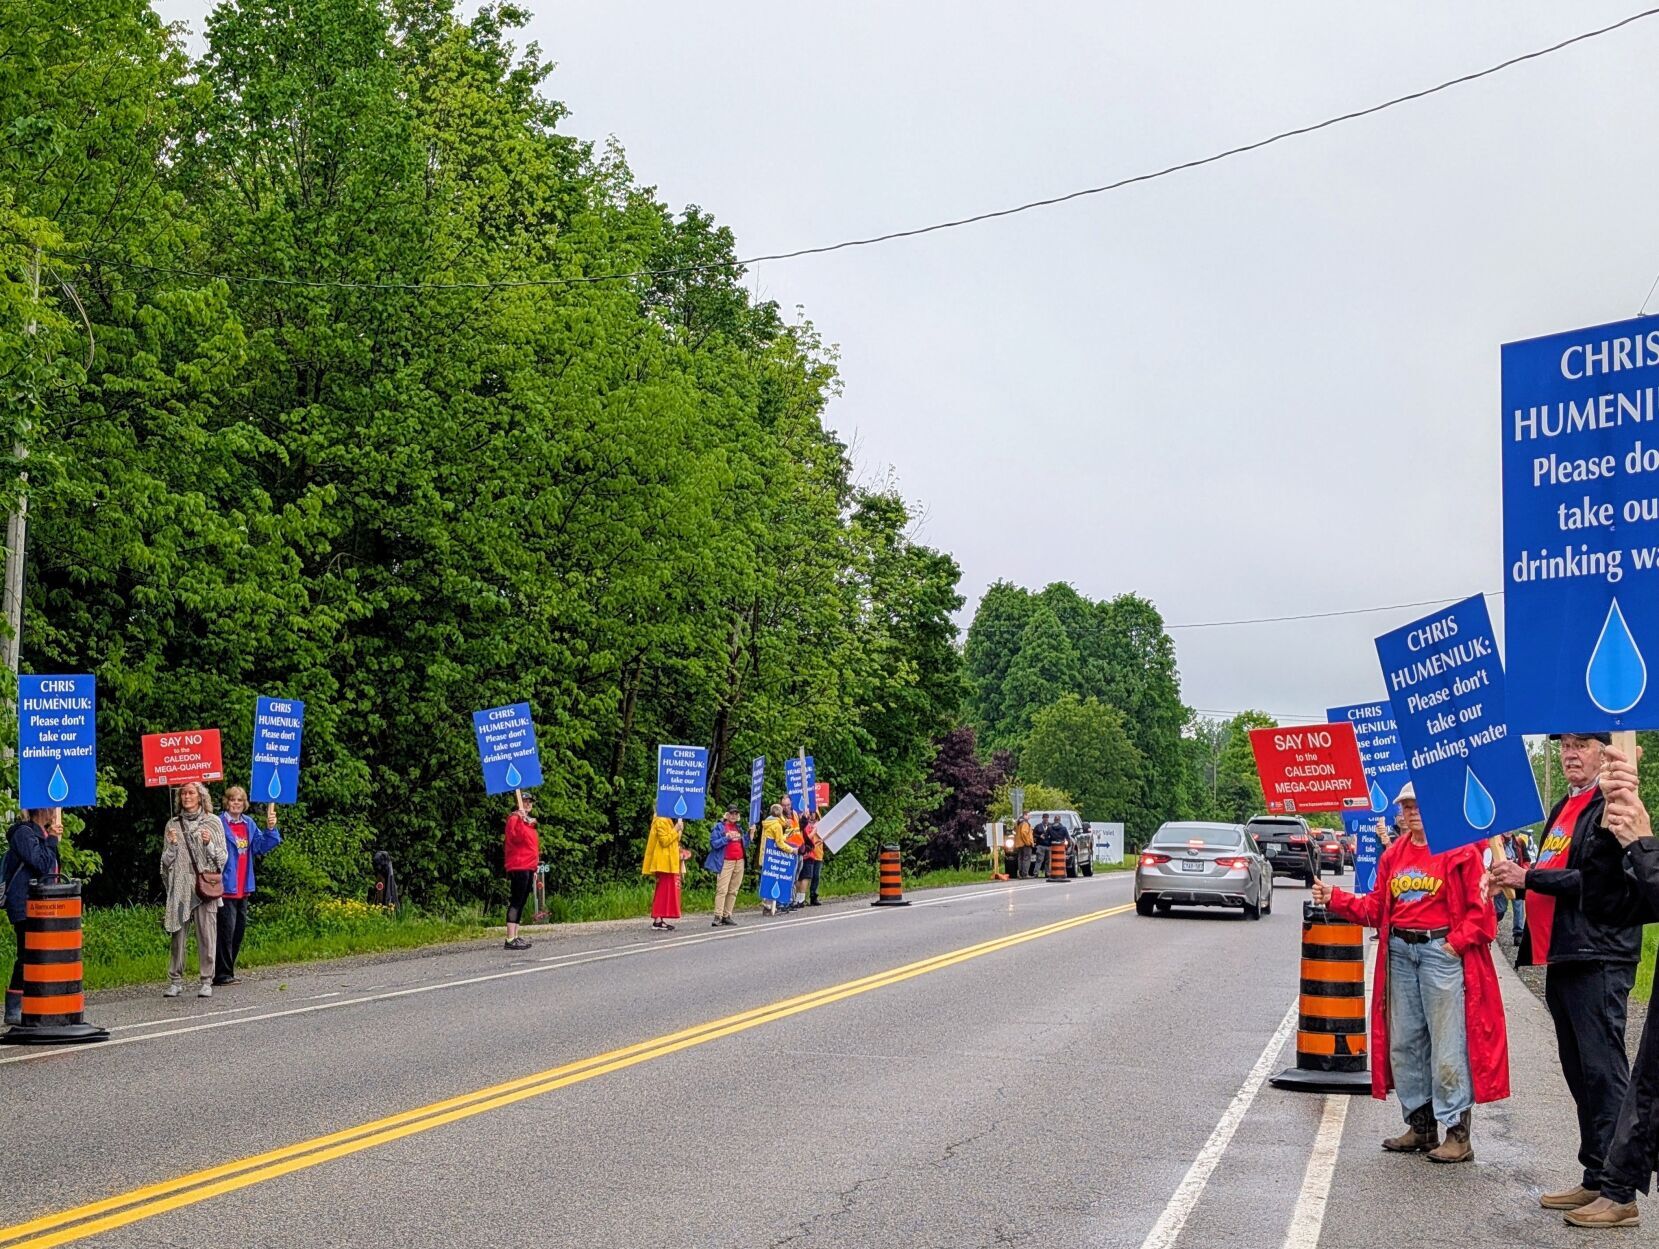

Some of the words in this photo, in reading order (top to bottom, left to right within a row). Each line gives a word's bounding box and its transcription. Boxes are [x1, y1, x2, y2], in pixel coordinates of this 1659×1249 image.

[1514, 386, 1659, 442] HUMENI
[1534, 453, 1615, 486] Please
[1558, 496, 1614, 531] take
[1513, 544, 1622, 583] drinking
[1407, 616, 1458, 651] CHRIS
[1390, 636, 1492, 691] HUMENIUK:
[41, 680, 75, 692] CHRIS
[1408, 687, 1450, 714] Please
[1453, 669, 1489, 696] don't
[24, 697, 92, 710] HUMENIUK:
[270, 702, 292, 713] CHRIS
[489, 708, 515, 720] CHRIS
[1348, 706, 1382, 720] CHRIS
[1427, 712, 1456, 735] take
[1460, 703, 1482, 723] our
[30, 716, 59, 726] Please
[62, 715, 85, 725] don't
[259, 715, 300, 728] HUMENIUK:
[479, 717, 529, 734] HUMENIUK:
[39, 731, 58, 742] take
[61, 732, 76, 741] our
[160, 736, 181, 747] SAY
[185, 735, 202, 745] NO
[261, 729, 280, 738] Please
[281, 730, 295, 740] don't
[486, 734, 507, 743] Please
[509, 729, 526, 738] don't
[1373, 735, 1396, 746] don't
[266, 742, 278, 751] take
[1274, 734, 1303, 751] SAY
[1308, 732, 1332, 748] NO
[23, 746, 61, 760] drinking
[64, 745, 92, 756] water!
[164, 754, 201, 763] CALEDON
[255, 752, 279, 765] drinking
[280, 756, 298, 764] water!
[484, 752, 512, 763] drinking
[513, 747, 535, 757] water!
[1305, 753, 1317, 761] the
[1374, 751, 1390, 760] our
[1412, 740, 1468, 769] drinking
[154, 762, 212, 773] MEGA-QUARRY
[663, 759, 705, 768] HUMENIUK:
[1378, 760, 1408, 772] water!
[1285, 764, 1335, 777] CALEDON
[660, 784, 684, 793] drinking
[1275, 779, 1352, 794] MEGA-QUARRY
[1391, 875, 1443, 898] BOOM!
